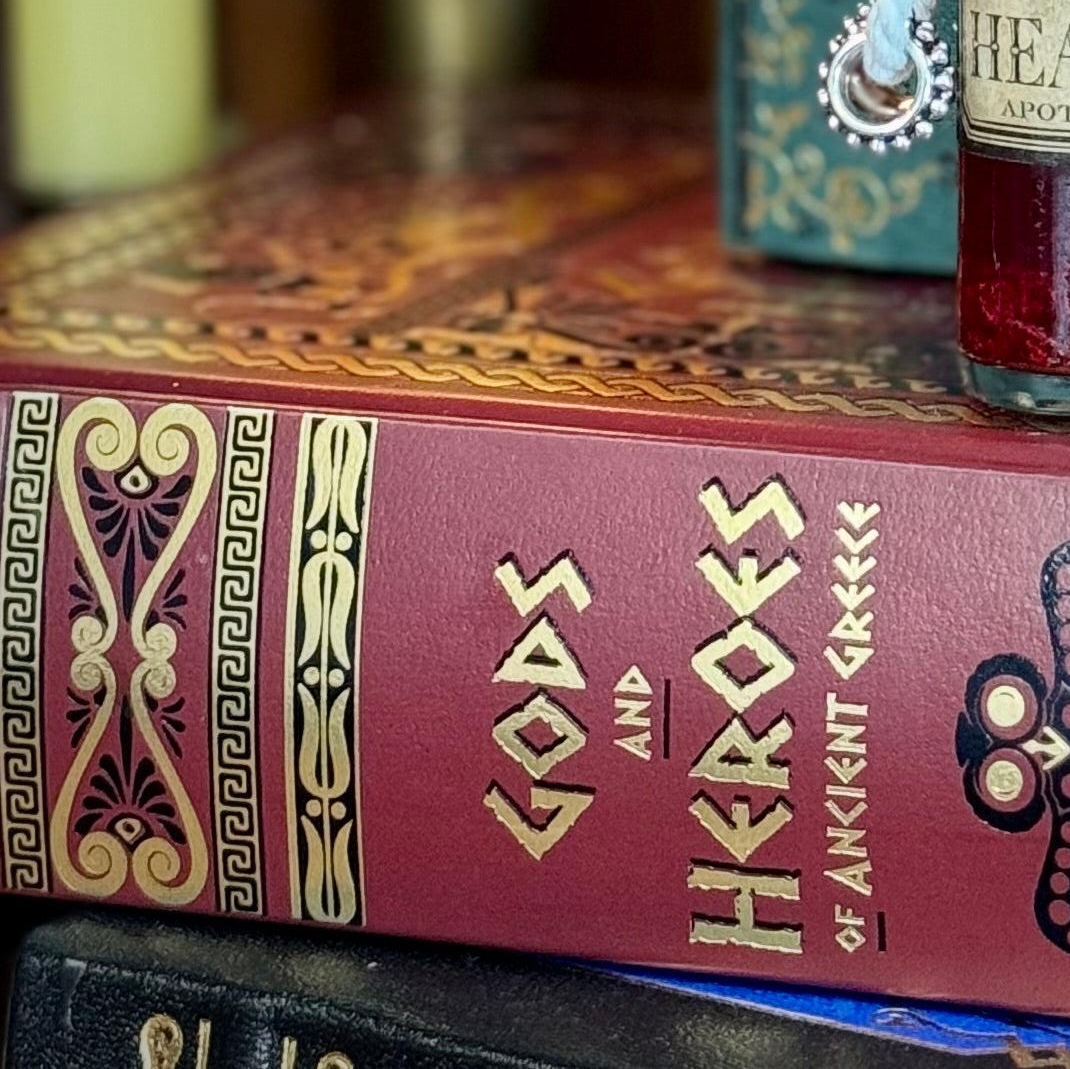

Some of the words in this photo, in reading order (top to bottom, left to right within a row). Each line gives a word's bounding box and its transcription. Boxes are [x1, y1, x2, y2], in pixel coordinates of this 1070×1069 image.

[823, 500, 881, 680] GREECE
[483, 548, 596, 862] GODS
[614, 664, 654, 761] AND
[687, 472, 807, 954] HEROES
[823, 692, 873, 896] ANCIENT
[834, 904, 867, 953] OF
